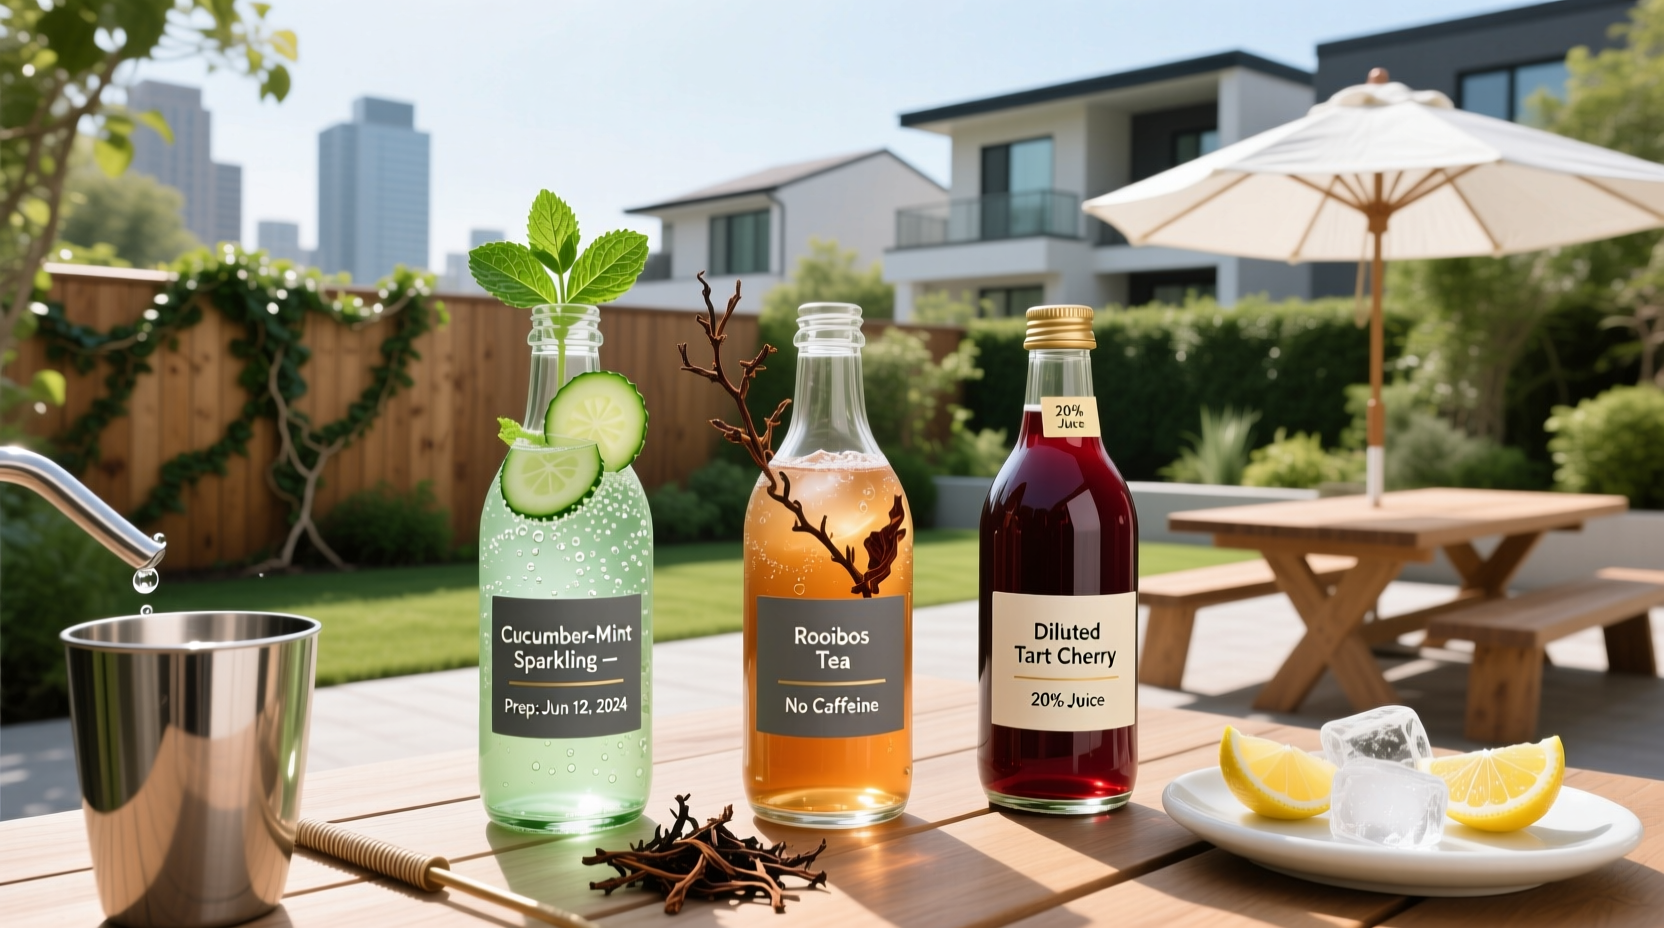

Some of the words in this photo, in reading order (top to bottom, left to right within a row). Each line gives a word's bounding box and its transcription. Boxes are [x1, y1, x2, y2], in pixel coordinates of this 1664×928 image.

[1056, 404, 1083, 417] 20%
[501, 624, 632, 644] Cucumber-Mint
[794, 627, 870, 645] Rooibos
[1034, 622, 1100, 640] Diluted
[514, 650, 597, 674] Sparkling
[816, 650, 850, 669] Tea
[1014, 645, 1052, 664] Tart
[1057, 646, 1116, 668] Cherry
[505, 698, 539, 719] Prep:
[541, 699, 569, 715] Jun
[573, 700, 592, 715] 12,
[596, 697, 628, 713] 2024
[785, 697, 808, 714] No
[812, 697, 879, 714] Caffeine
[1031, 692, 1064, 708] 20%
[1067, 693, 1105, 708] Juice
